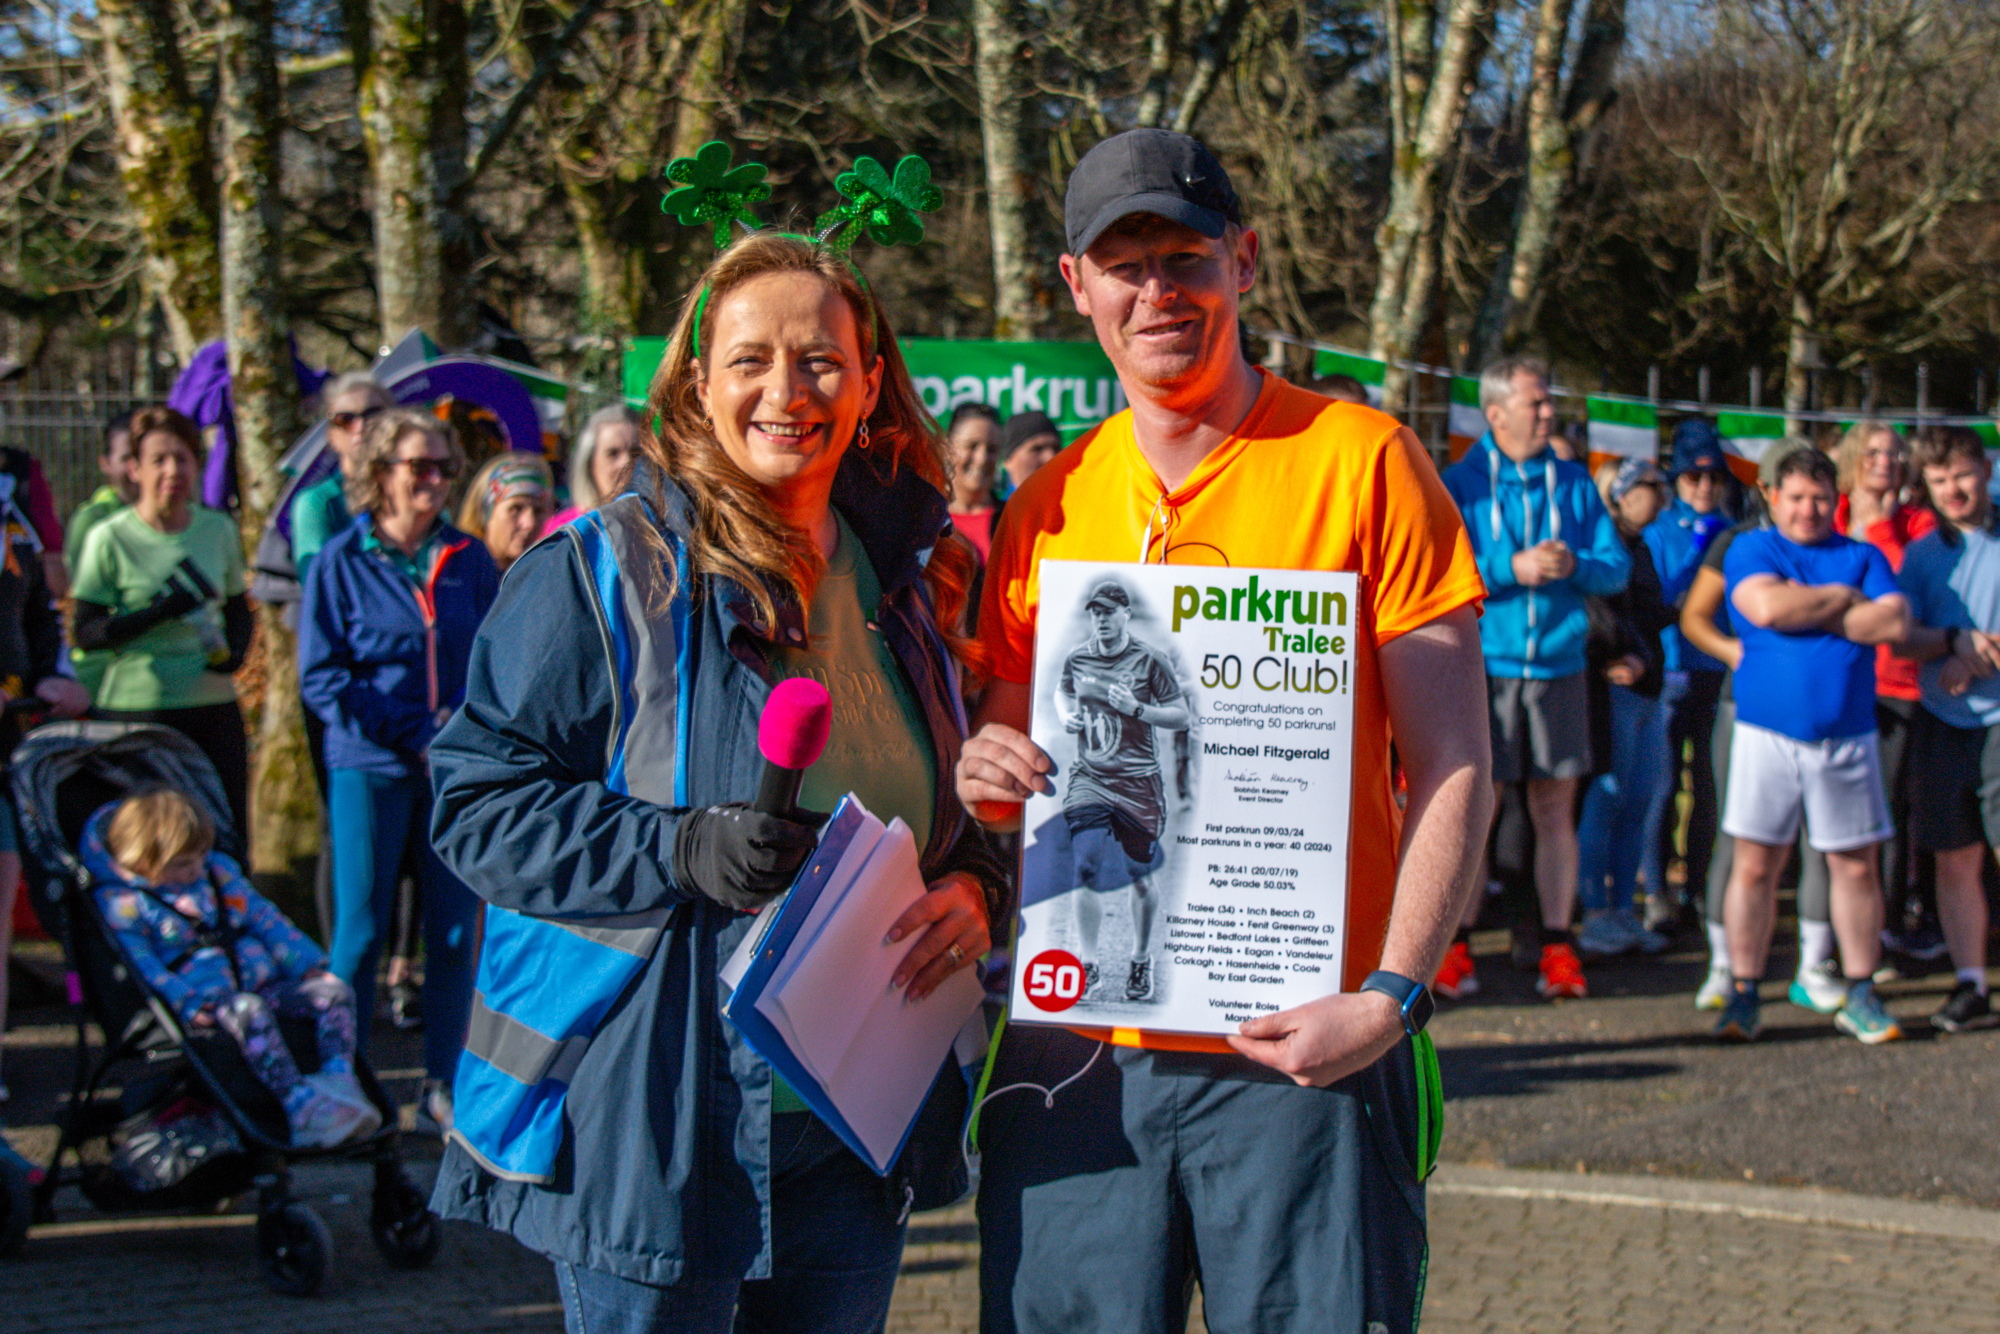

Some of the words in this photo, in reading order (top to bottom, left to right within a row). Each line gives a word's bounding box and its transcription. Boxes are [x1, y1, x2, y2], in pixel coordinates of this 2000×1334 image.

[1171, 575, 1347, 632] parkrun
[1262, 626, 1346, 655] Tralee
[1200, 654, 1241, 690] 50
[1253, 656, 1348, 695] Club!
[1213, 701, 1304, 715] Congratulations
[1307, 706, 1323, 716] on
[1199, 716, 1264, 729] completing
[1267, 718, 1281, 728] 50
[1285, 720, 1336, 731] parkruns!
[1204, 743, 1259, 757] Michael
[1264, 745, 1330, 761] Fitzgerald
[1238, 795, 1256, 803] Event
[1257, 795, 1284, 804] Director
[1262, 787, 1289, 796] Kearney
[1205, 823, 1223, 833] First
[1225, 824, 1261, 835] parkrun
[1263, 826, 1305, 837] 09/03/24
[1176, 835, 1199, 845] Most
[1201, 836, 1241, 848] parkruns
[1243, 838, 1251, 847] in
[1263, 841, 1287, 850] year:
[1289, 841, 1301, 850] 40
[1303, 842, 1332, 853] (2024)
[1208, 864, 1221, 873] PB:
[1224, 865, 1247, 874] 26:41
[1251, 866, 1299, 878] (20/07/19)
[1209, 877, 1228, 888] Age
[1231, 879, 1261, 888] Grade
[1263, 880, 1296, 891] 50.03%
[1187, 903, 1215, 912] Tralee
[1217, 904, 1235, 915] (34)
[1247, 907, 1267, 916] Inch
[1270, 908, 1300, 917] Beach
[1302, 909, 1315, 919] (2)
[1166, 915, 1205, 926] Killarney
[1207, 918, 1236, 927] House
[1247, 920, 1270, 929] Fenit
[1271, 921, 1320, 933] Greenway
[1322, 923, 1335, 934] (3)
[1170, 929, 1205, 939] Listowel
[1216, 932, 1252, 941] Bedfont
[1254, 934, 1281, 943] Lakes
[1292, 936, 1329, 946] Griffeen
[1164, 942, 1205, 953] Highbury
[1207, 944, 1233, 954] Fields
[1244, 947, 1274, 957] Eagan
[1285, 949, 1333, 960] Vandeleur
[1174, 956, 1215, 968] Corkagh
[1226, 960, 1281, 971] Hasenheide
[1292, 963, 1321, 973] Coole
[1029, 963, 1080, 999] 50
[1208, 971, 1226, 982] Bay
[1228, 973, 1246, 982] East
[1249, 974, 1285, 984] Garden
[1208, 998, 1253, 1010] Volunteer
[1255, 1001, 1280, 1011] Roles
[1225, 1013, 1261, 1023] Marsh
